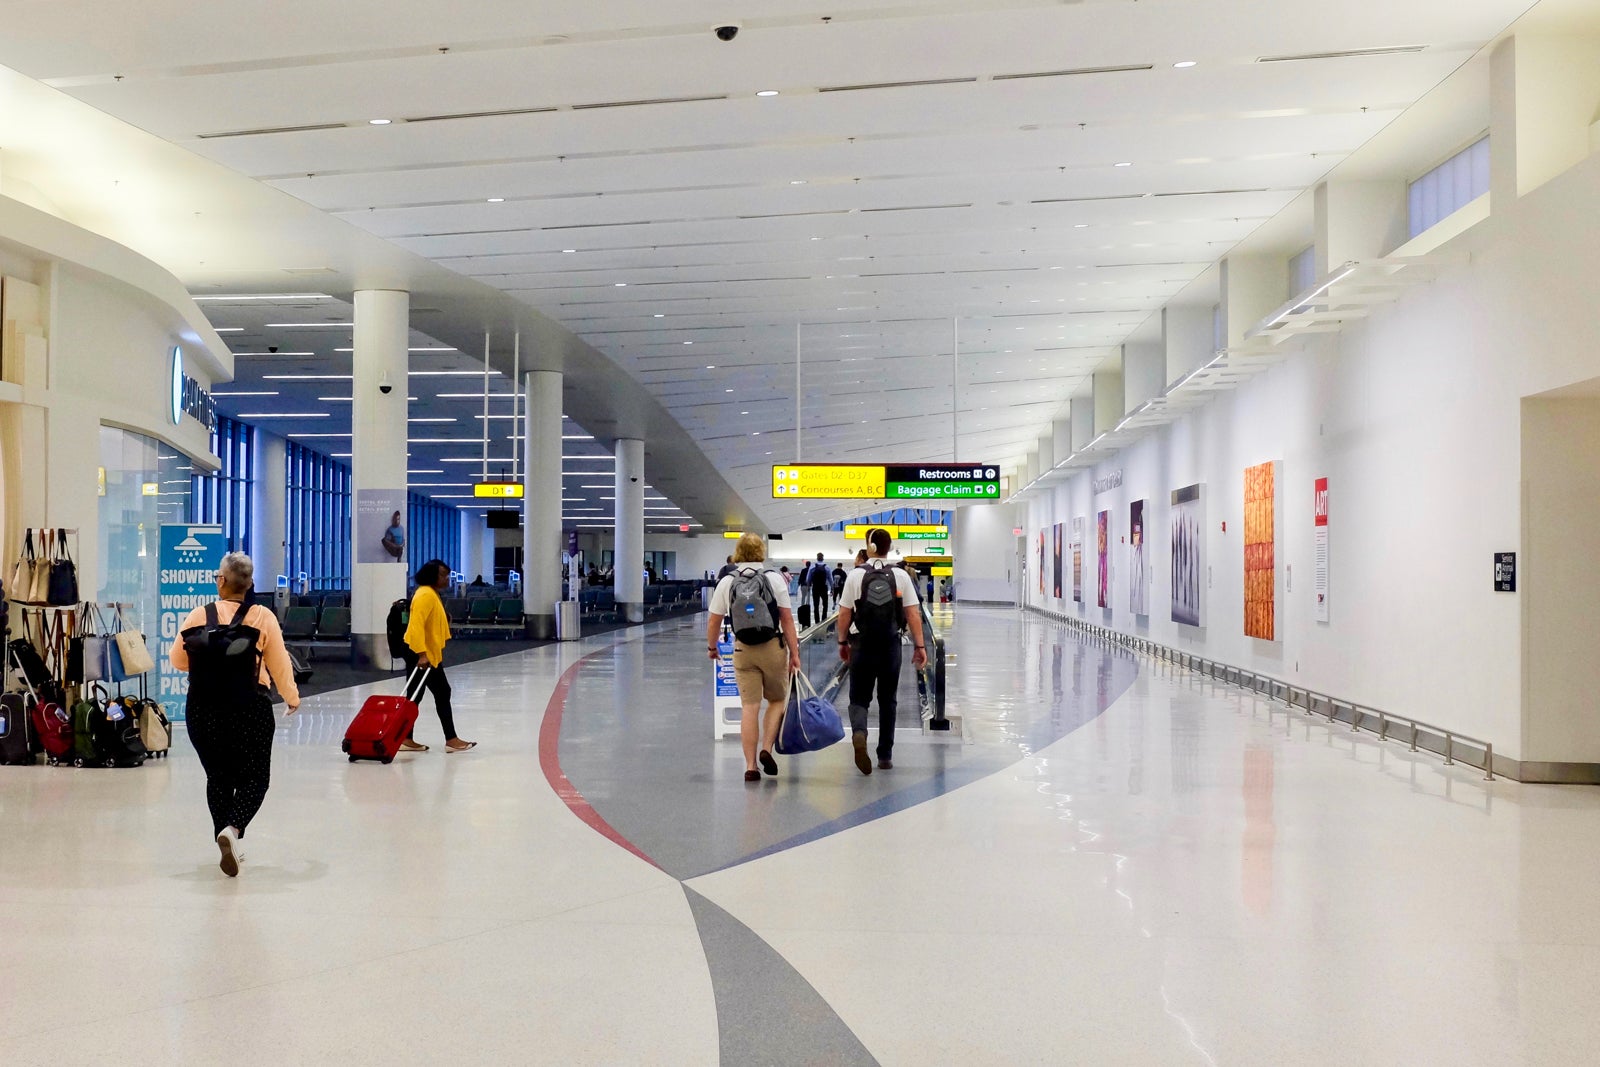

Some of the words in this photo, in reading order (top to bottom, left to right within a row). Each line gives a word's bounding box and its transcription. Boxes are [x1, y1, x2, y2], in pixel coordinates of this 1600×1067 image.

[801, 471, 828, 480] Gates
[919, 469, 971, 479] Restrooms
[492, 487, 504, 495] D1
[801, 486, 854, 494] Concourses
[897, 485, 941, 497] Baggage
[943, 484, 972, 495] Claim
[1315, 490, 1328, 516] ART
